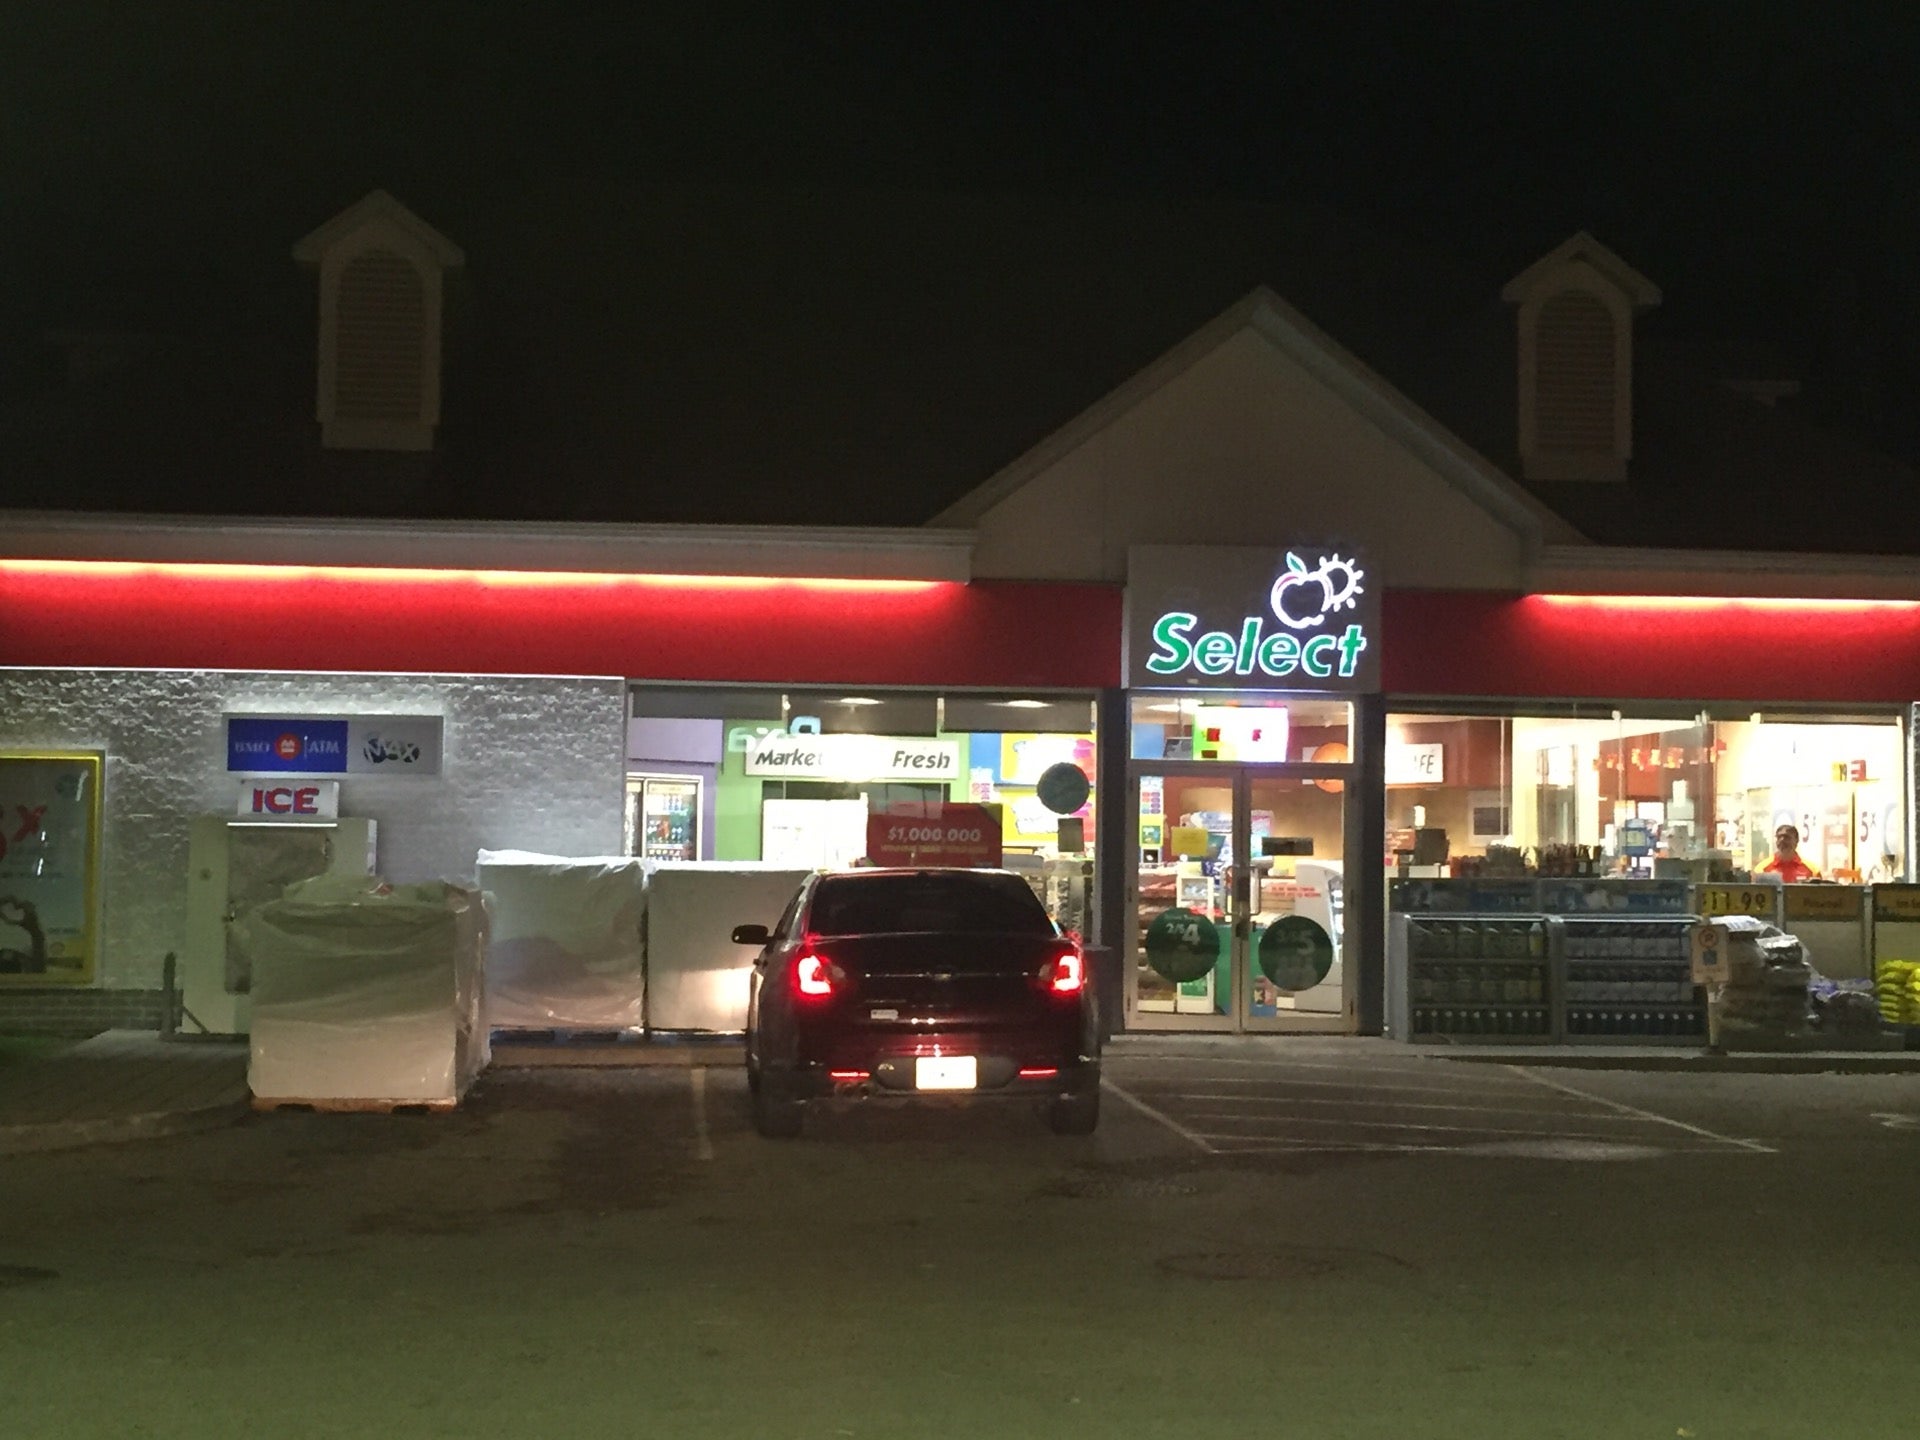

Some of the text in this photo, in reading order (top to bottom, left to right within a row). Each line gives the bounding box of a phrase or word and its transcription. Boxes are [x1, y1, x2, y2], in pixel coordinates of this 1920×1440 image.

[1146, 611, 1367, 678] Select
[308, 740, 340, 754] ATM
[892, 749, 951, 769] Fresh
[252, 787, 320, 814] ICE
